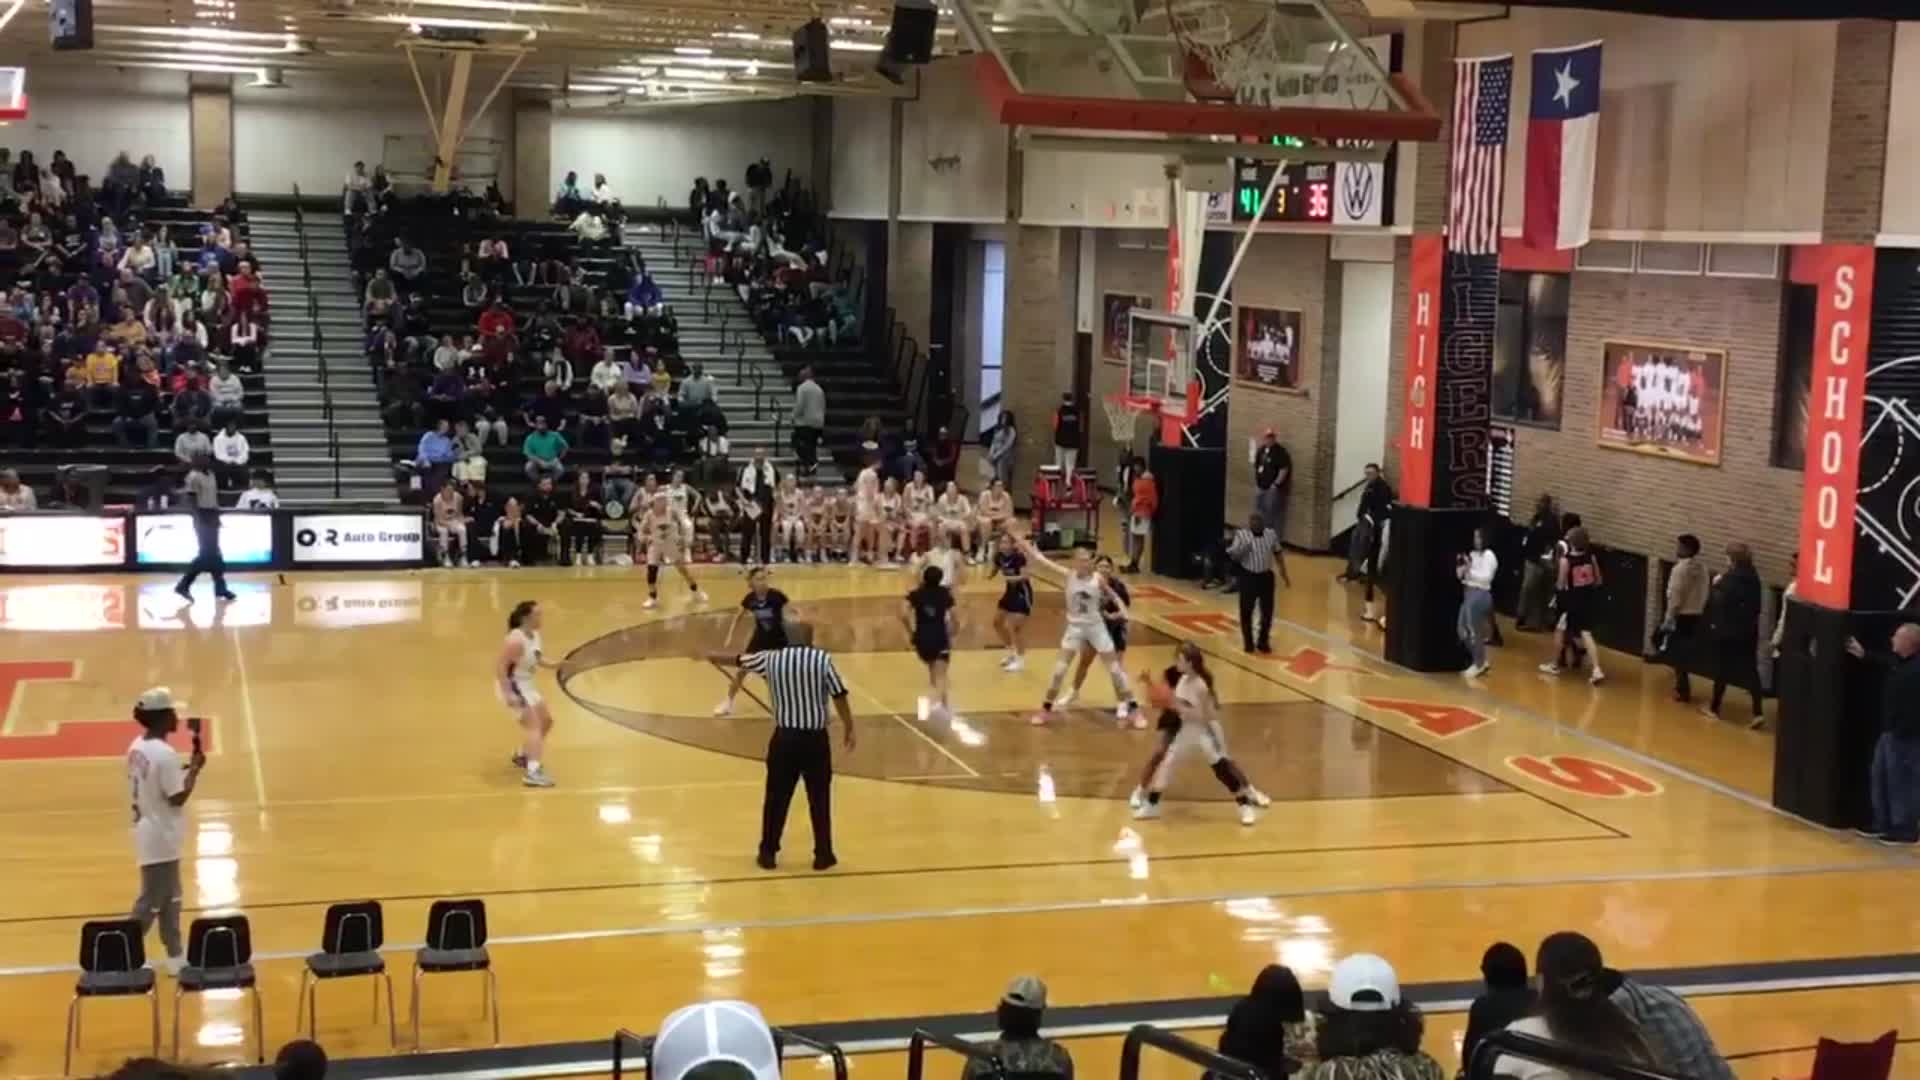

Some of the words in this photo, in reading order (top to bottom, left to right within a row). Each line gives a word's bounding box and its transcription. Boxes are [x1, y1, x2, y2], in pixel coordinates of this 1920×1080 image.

[1410, 292, 1431, 450] HIGH
[1812, 264, 1856, 585] SCHOOL
[343, 532, 376, 544] Auto
